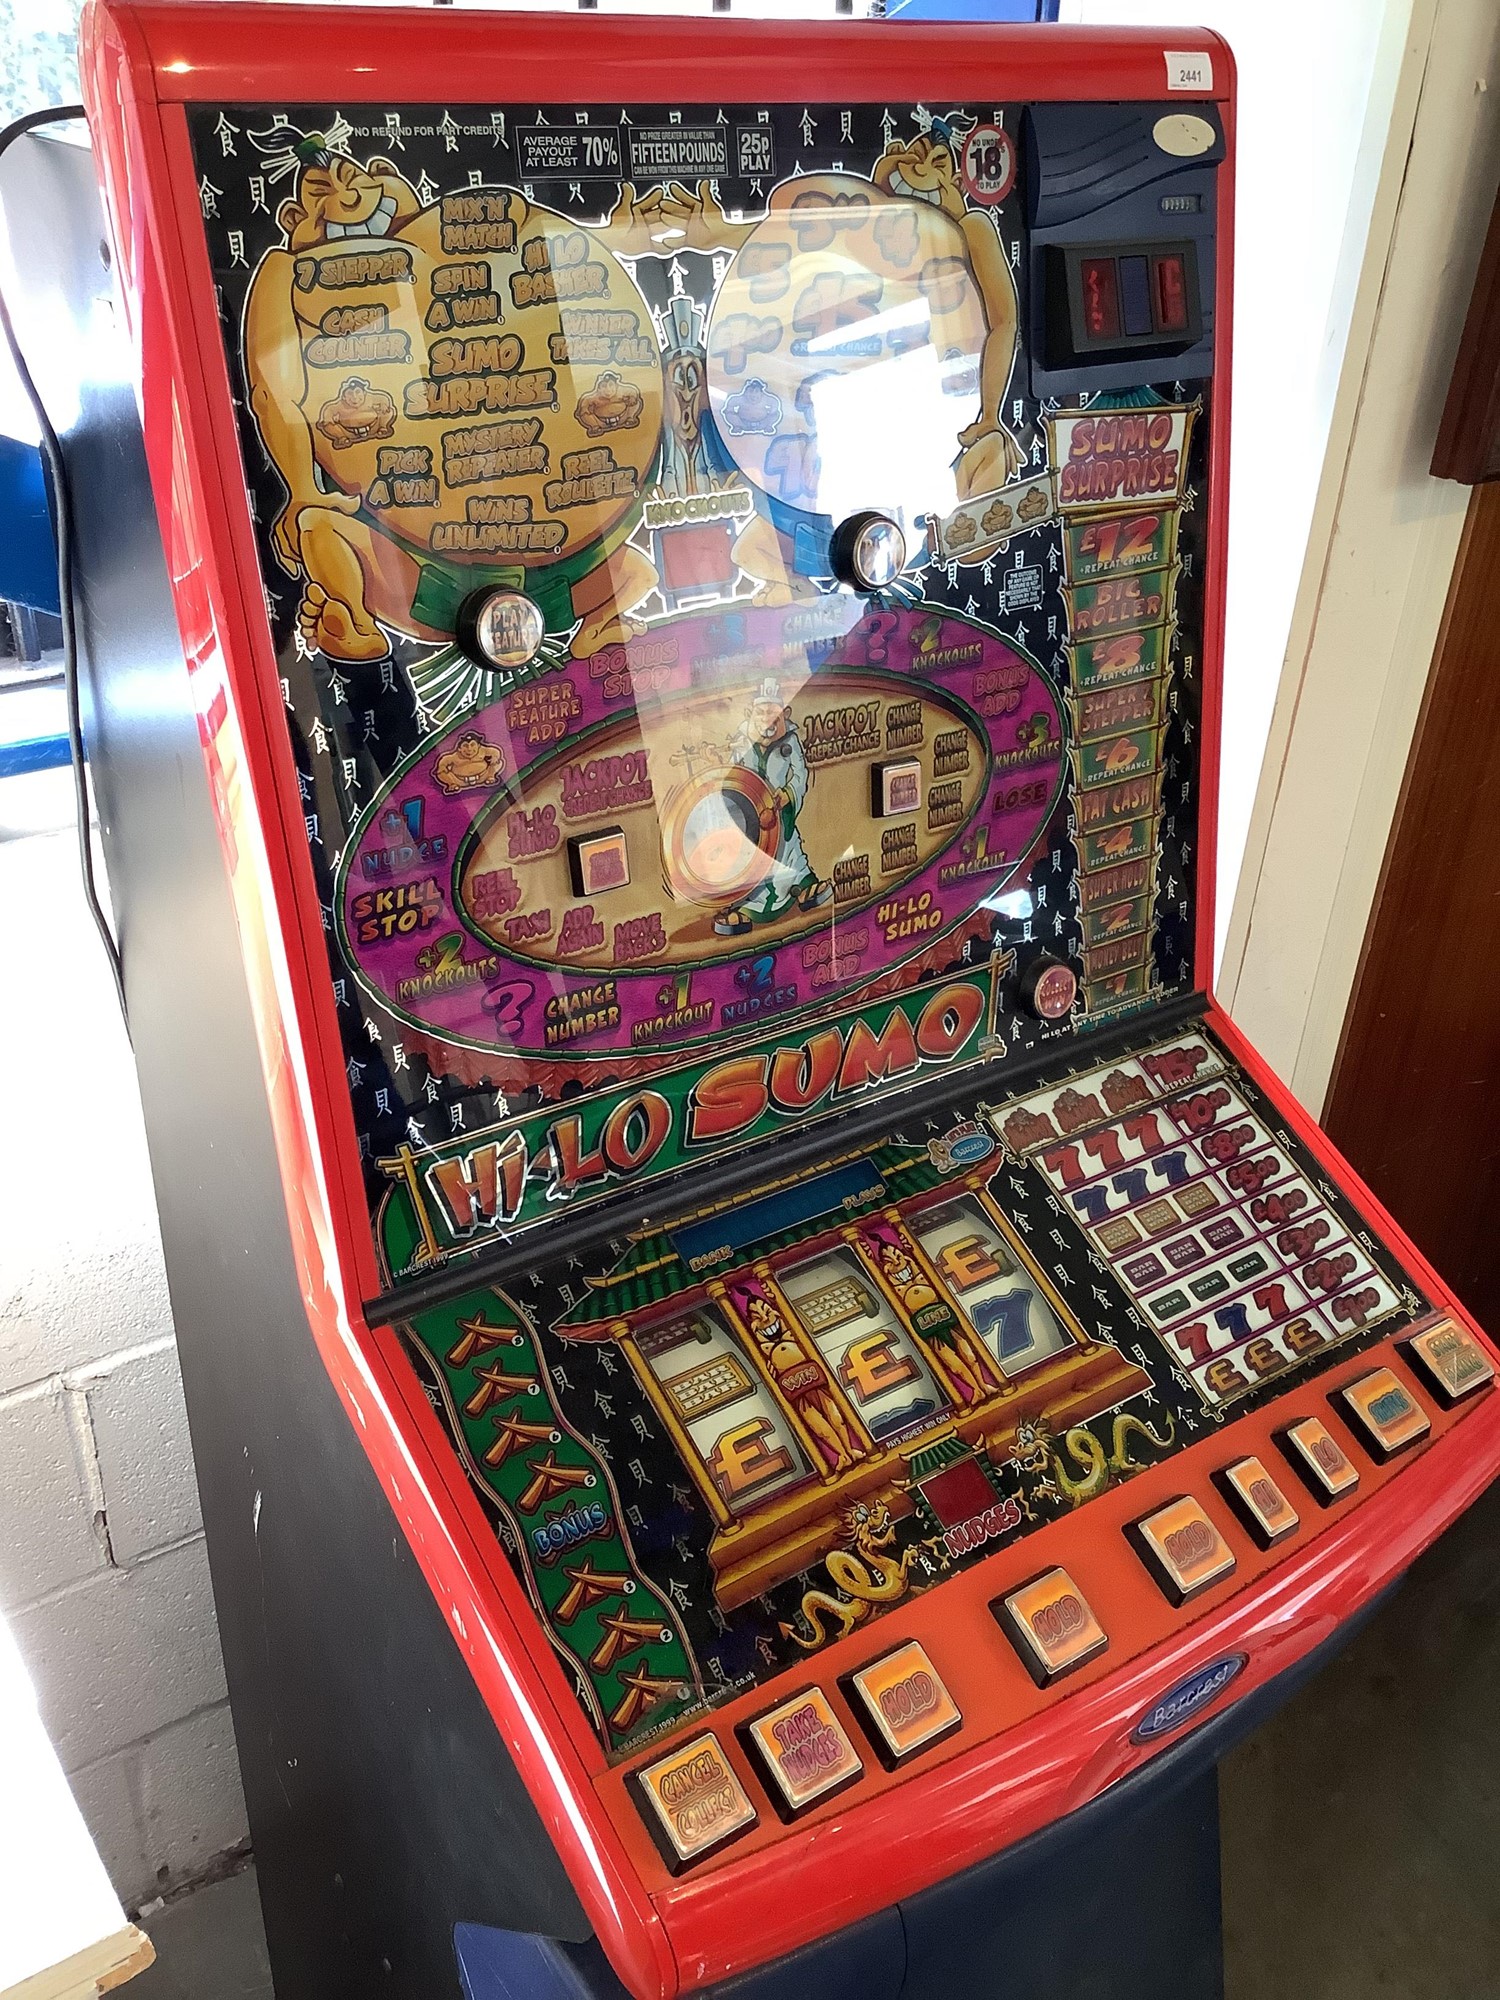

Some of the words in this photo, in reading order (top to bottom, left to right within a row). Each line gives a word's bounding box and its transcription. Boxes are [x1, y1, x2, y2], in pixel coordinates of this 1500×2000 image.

[1180, 70, 1201, 82] 2441
[354, 129, 370, 137] NO
[372, 127, 412, 137] REFUND
[414, 127, 434, 136] FOR
[437, 126, 462, 136] PART
[463, 125, 504, 135] CREDITS
[523, 136, 577, 146] AVERAGE
[741, 133, 769, 154] 25p
[525, 157, 541, 167] AT
[542, 156, 578, 167] LEAST
[528, 147, 573, 156] PAYOUT
[582, 136, 618, 166] 70%
[632, 143, 678, 163] FIFTEEN
[679, 141, 725, 163] POUNDS
[740, 155, 771, 171] PLAY
[443, 197, 483, 222] MIX
[444, 223, 513, 250] MATCH
[552, 235, 587, 267] LO
[296, 260, 315, 288] 7
[320, 253, 409, 286] STEPPER
[434, 264, 488, 294] SPIN
[512, 263, 606, 301] BASHER
[320, 308, 386, 335] CASH
[428, 299, 450, 328] A
[453, 293, 498, 322] WIN
[562, 313, 637, 336] WINNER
[307, 335, 407, 365] COUNTER
[431, 339, 522, 374] SUMO
[550, 336, 609, 362] TAKES
[615, 335, 652, 363] ALL
[404, 372, 555, 416] SURPRISE
[443, 420, 539, 457] MYSTERY
[1069, 412, 1173, 457] SUMO
[377, 448, 431, 476] PICK
[446, 446, 545, 485] REPEATER
[564, 450, 614, 478] REEL
[1060, 449, 1179, 502] SURPRISE
[394, 478, 437, 502] WIN
[545, 475, 635, 509] ROULETTE
[466, 497, 530, 524] WINS
[645, 492, 750, 526] KNOCKOUTS
[431, 522, 565, 552] UNLIMITED
[1079, 515, 1160, 562] £12
[1122, 551, 1159, 566] CHANCE
[1096, 579, 1141, 606] BIG
[1076, 595, 1161, 629] ROLLER
[588, 640, 679, 678] BONUS
[911, 643, 983, 672] KNOCKOUTS
[1121, 661, 1157, 677] CHANCE
[511, 682, 572, 709] SUPER
[603, 668, 672, 698] STOP
[973, 664, 1030, 697] BONUS
[508, 699, 582, 729] FEATURE
[981, 691, 1022, 718] ADD
[1084, 687, 1137, 714] SUPER
[804, 701, 881, 745] JACKPOT
[886, 702, 922, 730] CHANGE
[1082, 702, 1153, 733] STEPPER
[527, 720, 568, 745] ADD
[843, 730, 881, 756] CHANCE
[887, 723, 923, 750] NUMBER
[934, 728, 969, 756] CHANGE
[934, 750, 970, 778] NUMBER
[994, 740, 1062, 770] KNOCKOUTS
[1120, 758, 1152, 774] CHANCE
[560, 750, 648, 802] JACKPOT
[928, 780, 962, 808] CHANGE
[993, 781, 1048, 812] LOSE
[1082, 789, 1109, 823] FAT
[1112, 779, 1150, 814] CASH
[928, 801, 964, 829] NUMBER
[881, 823, 916, 850] CHANGE
[1119, 844, 1147, 859] CHANCE
[361, 837, 448, 881] NUDGE
[834, 854, 869, 881] CHANGE
[881, 844, 917, 873] NUMBER
[939, 851, 1007, 885] KNOCKOUT
[834, 875, 871, 903] NUMBER
[1088, 871, 1119, 901] SUPER
[1120, 862, 1146, 893] HOLD
[352, 877, 442, 919] SKILL
[473, 887, 522, 920] STOP
[877, 892, 932, 923] HI-LO
[359, 902, 442, 943] STOP
[886, 910, 943, 942] SUMO
[802, 930, 870, 968] BONUS
[398, 956, 499, 999] KNOCKOUTS
[812, 955, 862, 985] ADD
[546, 982, 616, 1018] CHANGE
[721, 986, 798, 1021] NUDGES
[1118, 997, 1151, 1013] ADVANCE
[1151, 986, 1179, 1001] LADDER
[546, 1006, 619, 1046] NUMBER
[632, 1001, 714, 1044] KNOCKOUT
[686, 984, 985, 1147] SUMO
[842, 1184, 887, 1210] PLAYS
[689, 1245, 734, 1273] BANK
[1235, 1259, 1259, 1273] BAR
[917, 1307, 952, 1331] LINE
[781, 1365, 820, 1392] WIN
[885, 1437, 901, 1449] PAYS
[901, 1425, 925, 1442] HIGHEST
[936, 1412, 951, 1424] ONLY
[532, 1502, 607, 1557] BONUS
[943, 1499, 1022, 1558] NUDGES
[1163, 1520, 1214, 1567] HOLD
[1031, 1594, 1085, 1646] HOLD
[879, 1671, 936, 1728] HOLD
[1153, 1664, 1230, 1730] Barcrest
[772, 1703, 824, 1751] TAKE
[780, 1726, 844, 1784] NUDGES
[660, 1749, 723, 1806] CANCEL
[676, 1784, 738, 1840] COLLECT
